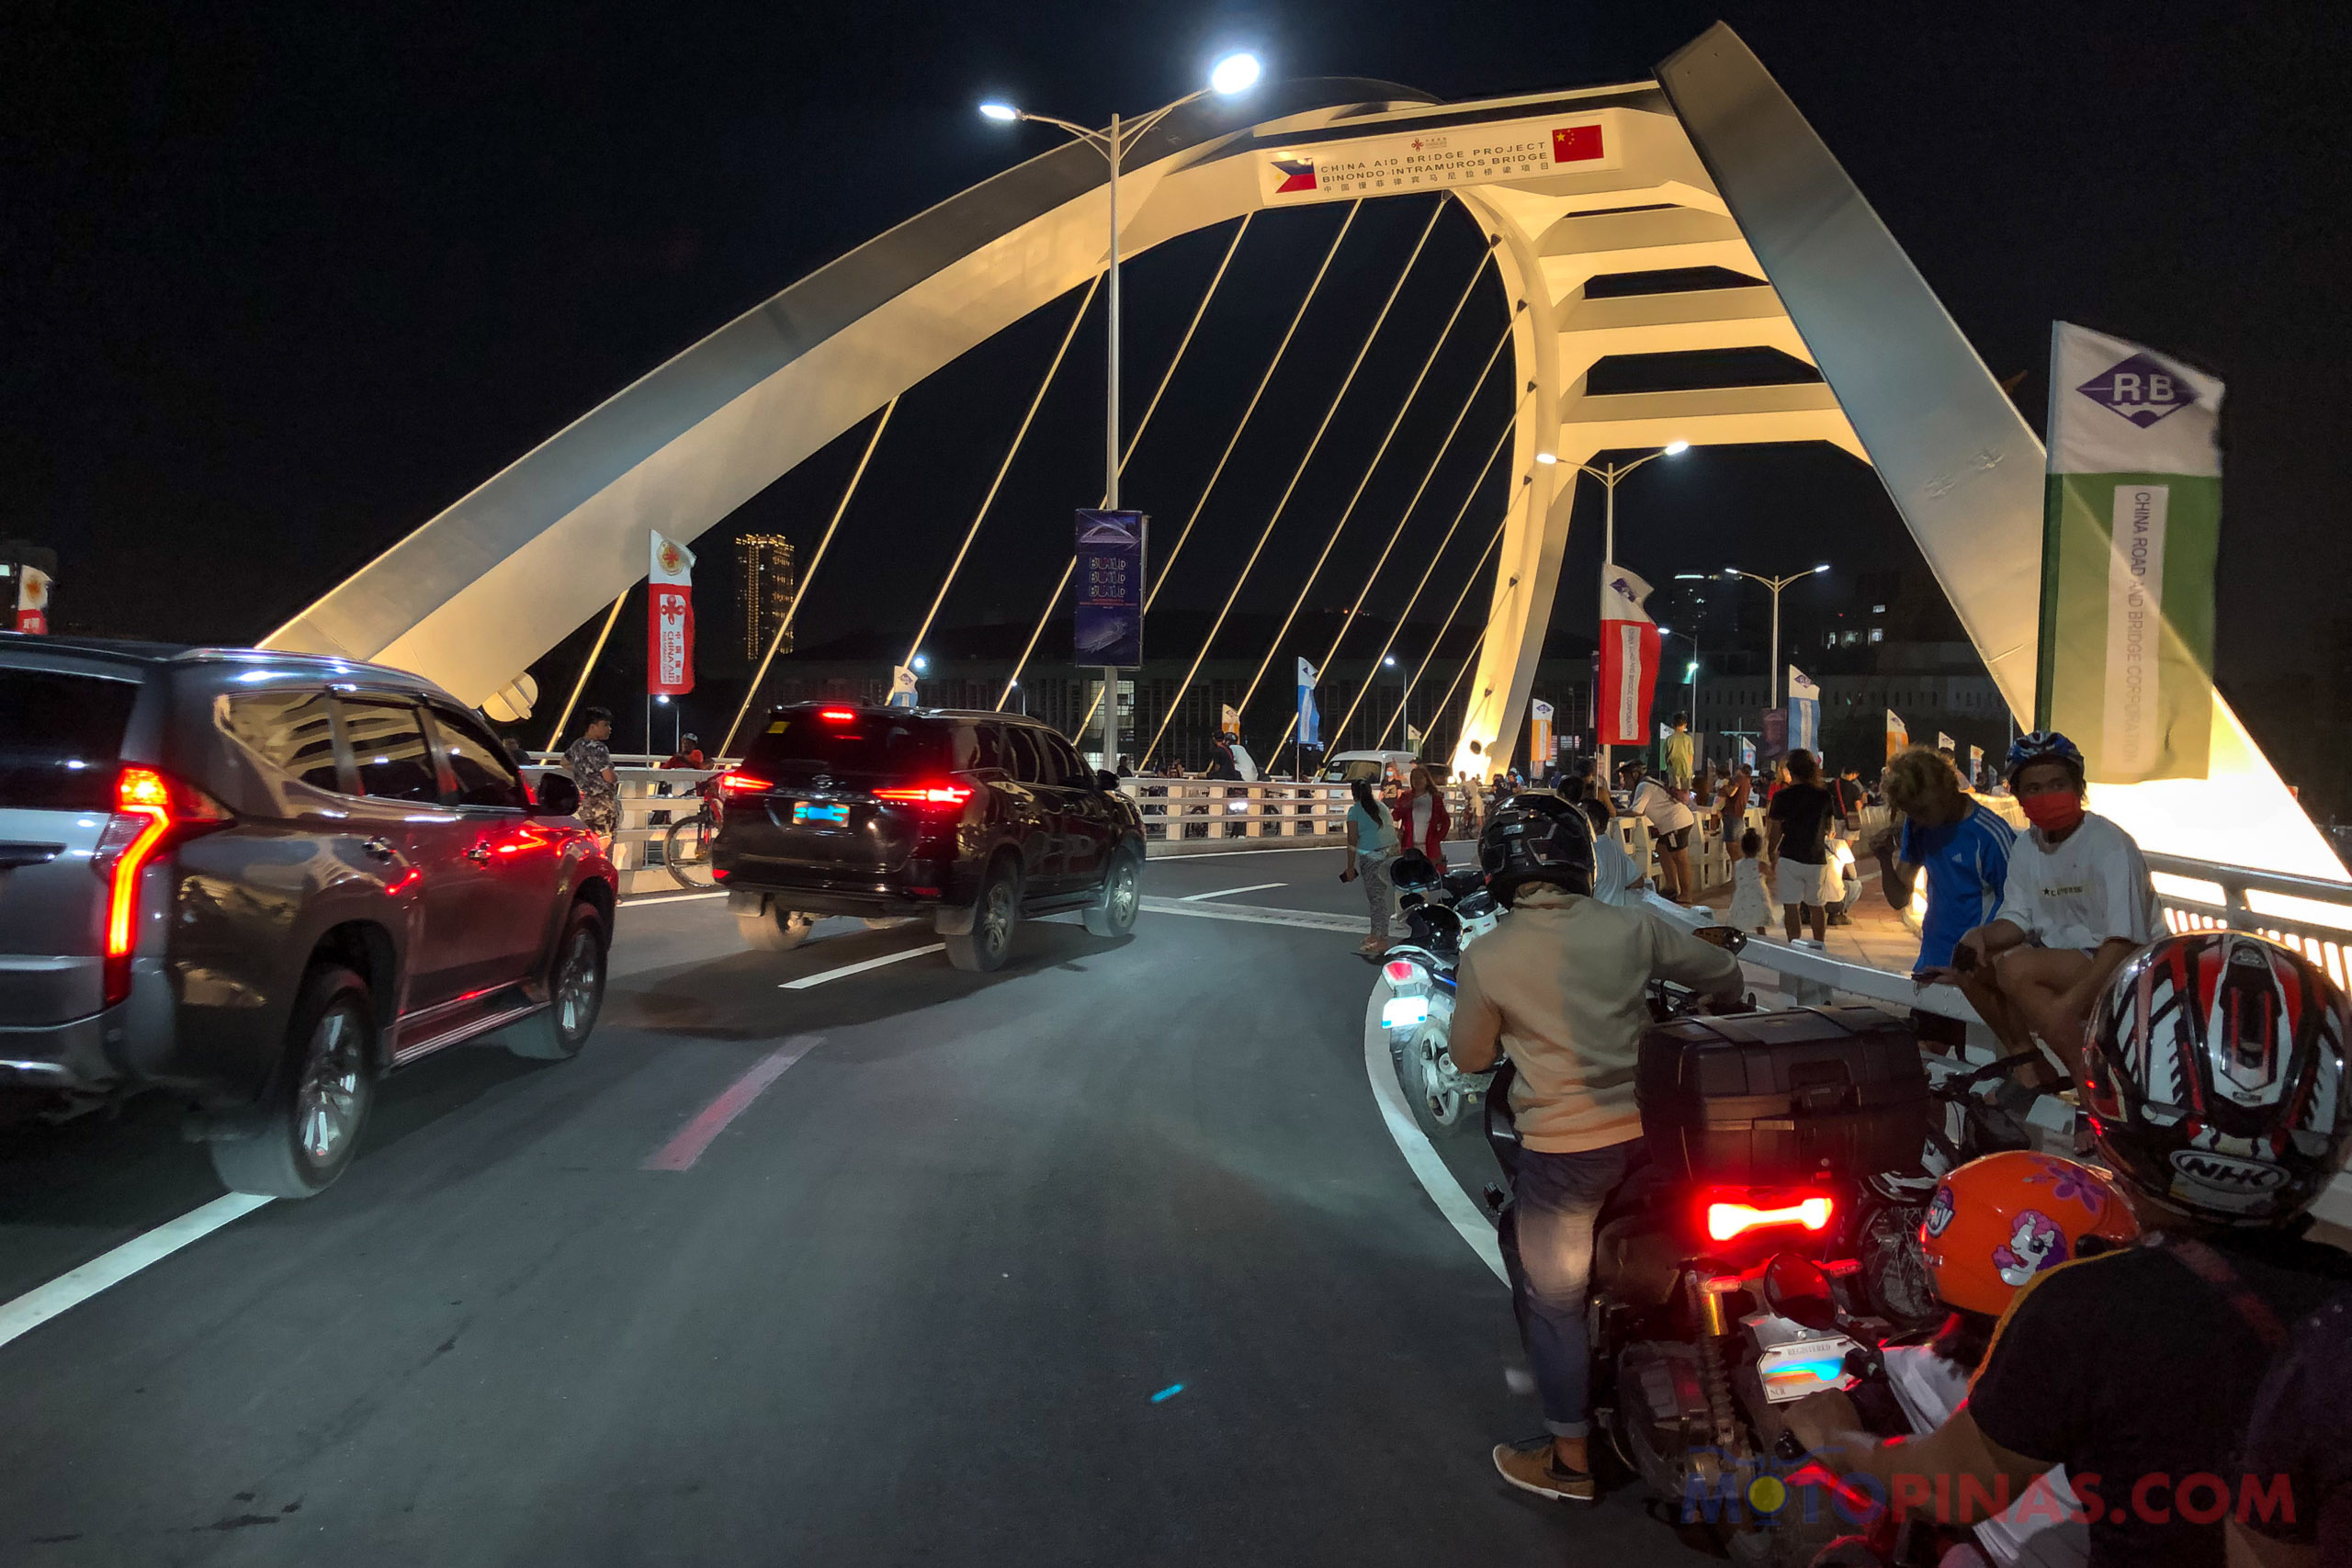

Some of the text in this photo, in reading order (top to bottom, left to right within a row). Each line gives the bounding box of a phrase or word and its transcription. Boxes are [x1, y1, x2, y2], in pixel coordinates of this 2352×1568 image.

[1320, 141, 1545, 173] CHINA AID BRIDGE PROJECT
[1322, 152, 1548, 183] BINONDO-INTRAMUROS BRIDGE
[2132, 491, 2151, 534] CHINA
[1090, 558, 1126, 570] BUILD
[2131, 537, 2148, 577] ROAD
[1088, 584, 1126, 598] BUILD
[1089, 570, 1126, 584] BUILD
[2126, 611, 2143, 662] BRIDGE
[2184, 1156, 2273, 1187] NHK
[1787, 1345, 1831, 1356] REGISTERED
[1770, 1388, 1786, 1396] NCR
